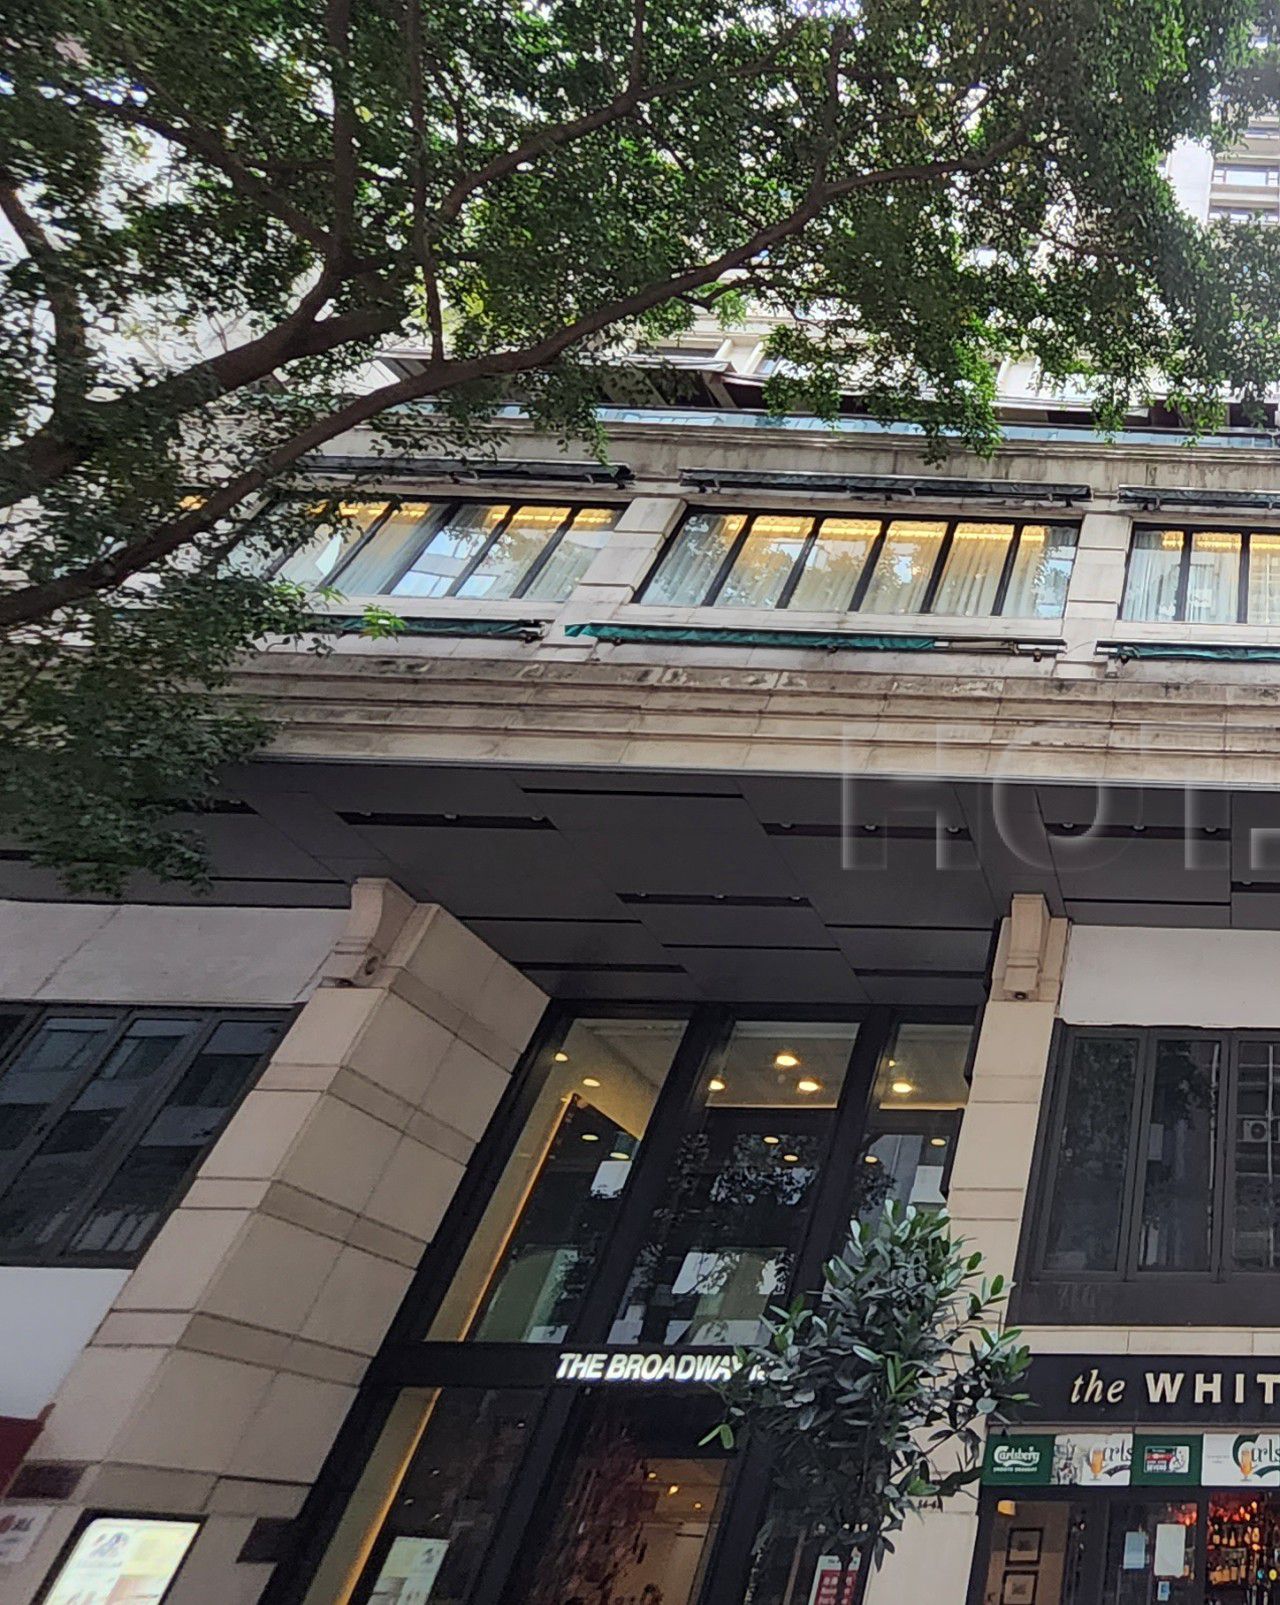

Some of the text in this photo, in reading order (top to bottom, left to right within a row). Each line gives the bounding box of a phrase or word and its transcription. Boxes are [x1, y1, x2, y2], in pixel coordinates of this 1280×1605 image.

[556, 1353, 605, 1380] THE
[1070, 1369, 1126, 1404] the
[993, 1445, 1041, 1467] Carlsberg
